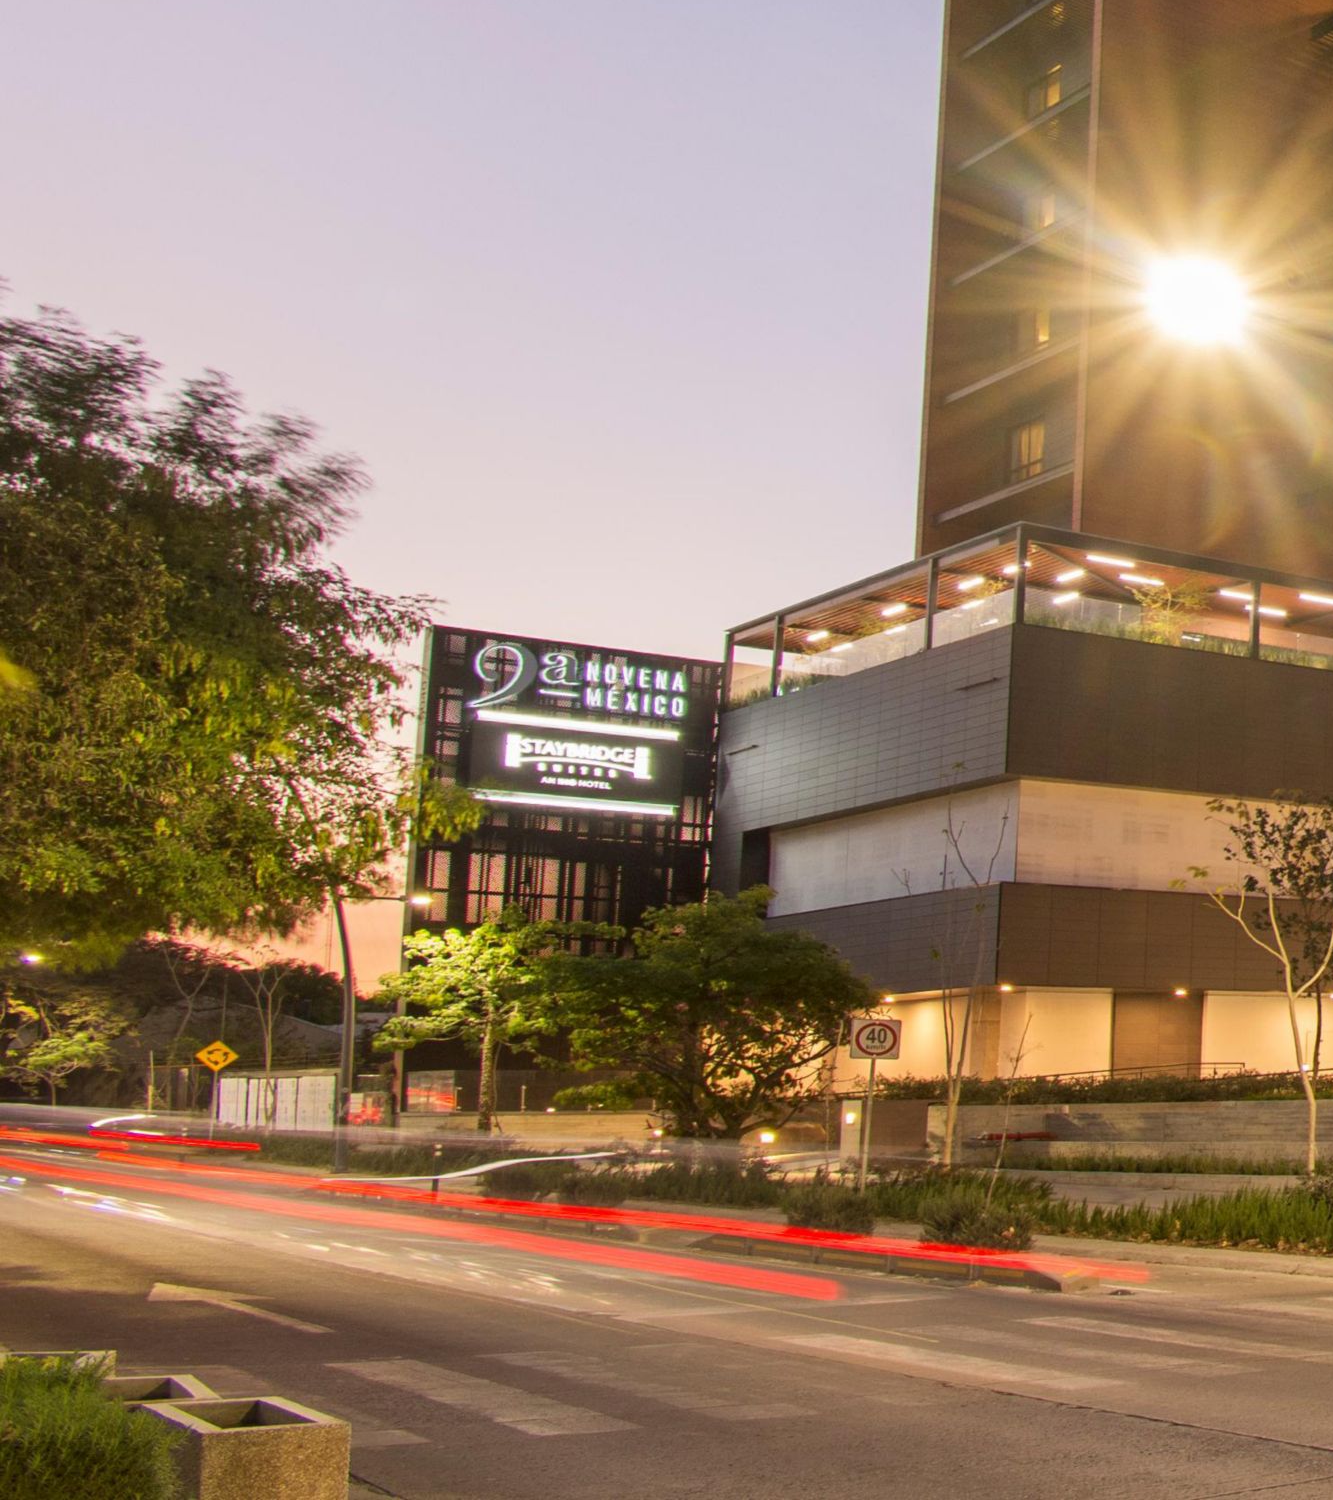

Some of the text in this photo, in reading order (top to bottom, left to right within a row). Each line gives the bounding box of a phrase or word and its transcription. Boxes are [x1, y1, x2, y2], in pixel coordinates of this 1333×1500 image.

[585, 660, 688, 693] NOVENA
[585, 686, 688, 718] MÉXICO
[519, 737, 635, 764] STAYBRIDGE
[536, 762, 619, 779] SUITES
[578, 779, 613, 790] HOTEL
[866, 1028, 887, 1043] 40
